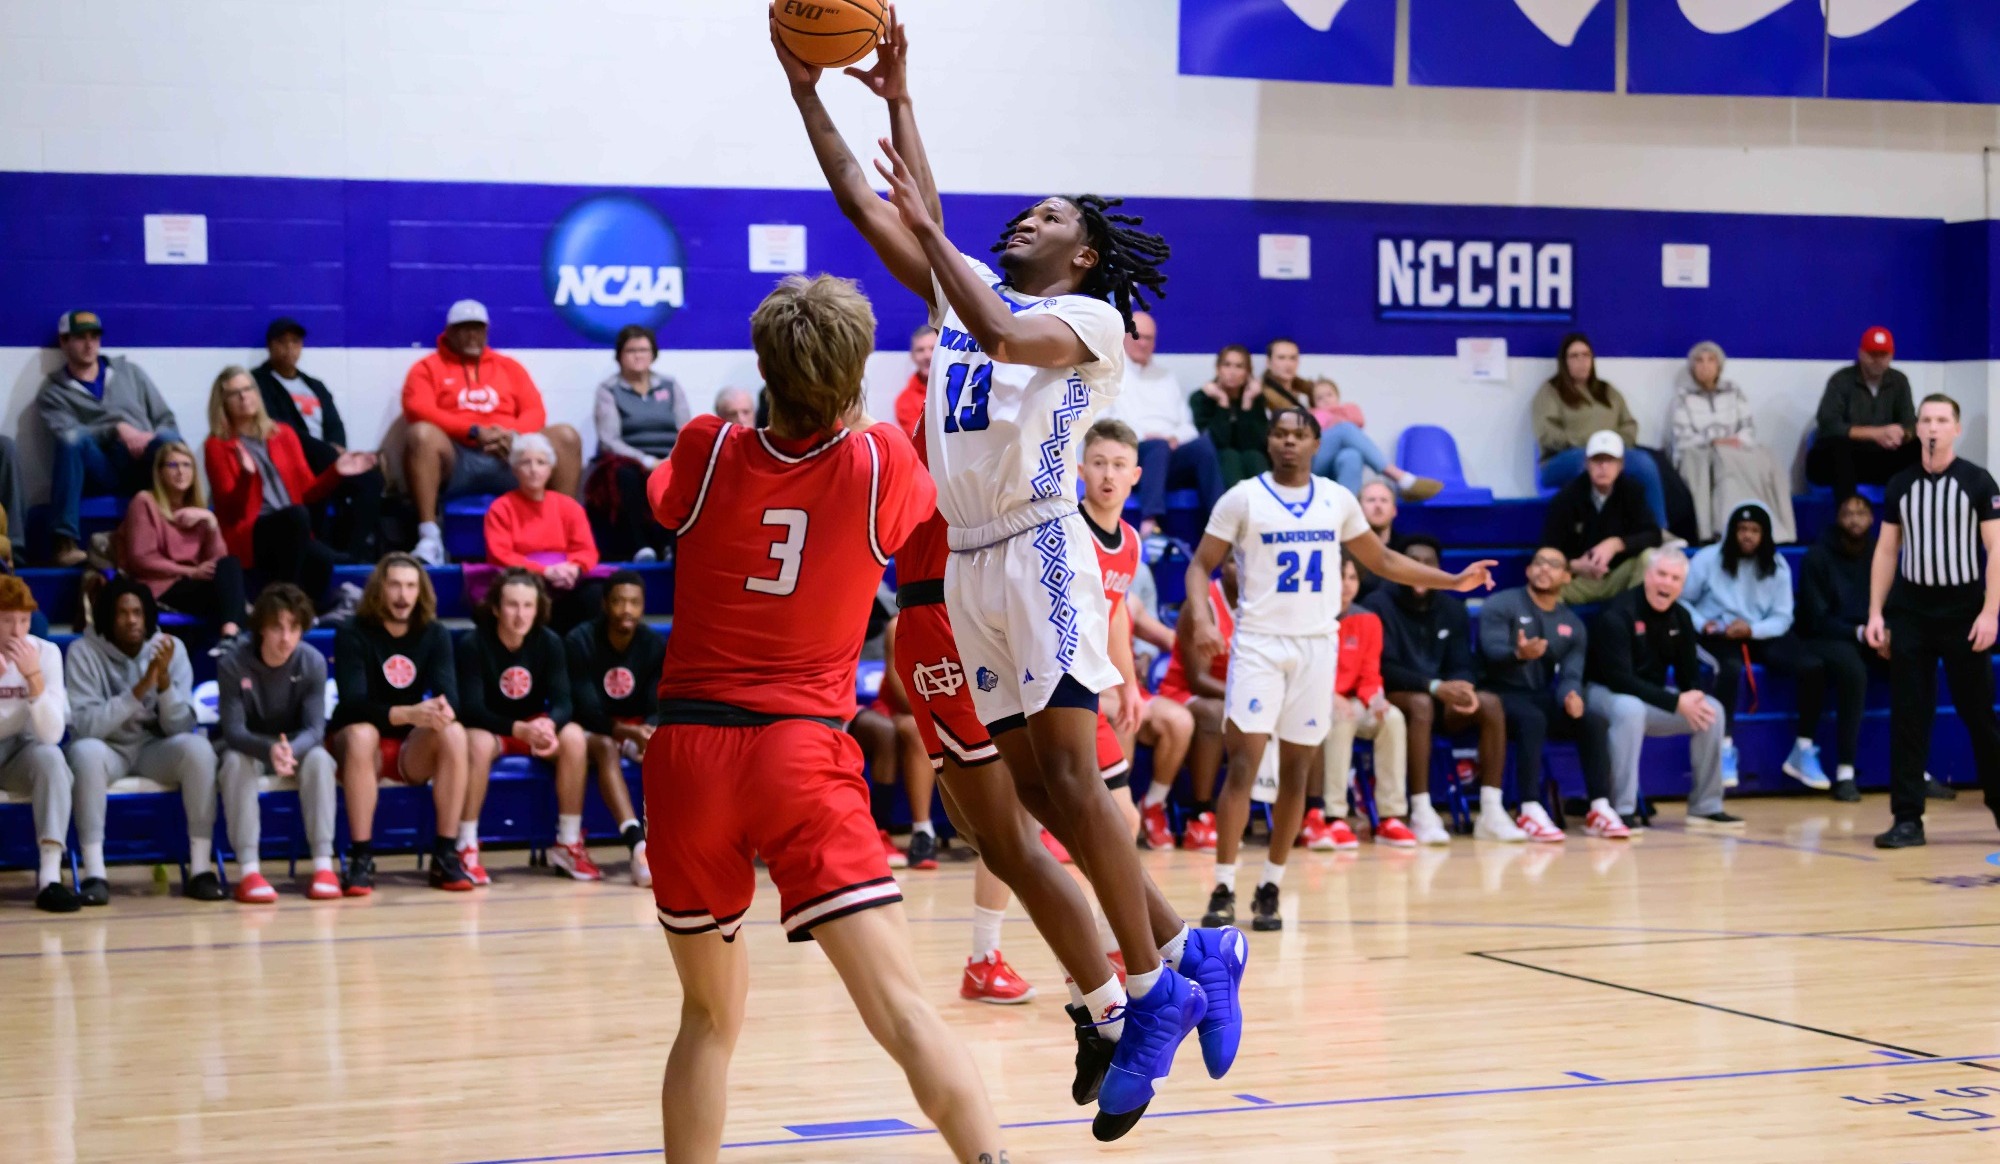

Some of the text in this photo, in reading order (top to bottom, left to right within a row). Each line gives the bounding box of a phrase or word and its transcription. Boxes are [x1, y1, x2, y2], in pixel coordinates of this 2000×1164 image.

[784, 0, 824, 20] EVO
[554, 265, 684, 308] NCAA
[1378, 239, 1572, 308] NCCAA
[944, 361, 994, 433] 13
[744, 507, 809, 597] 3
[1276, 550, 1323, 592] 24
